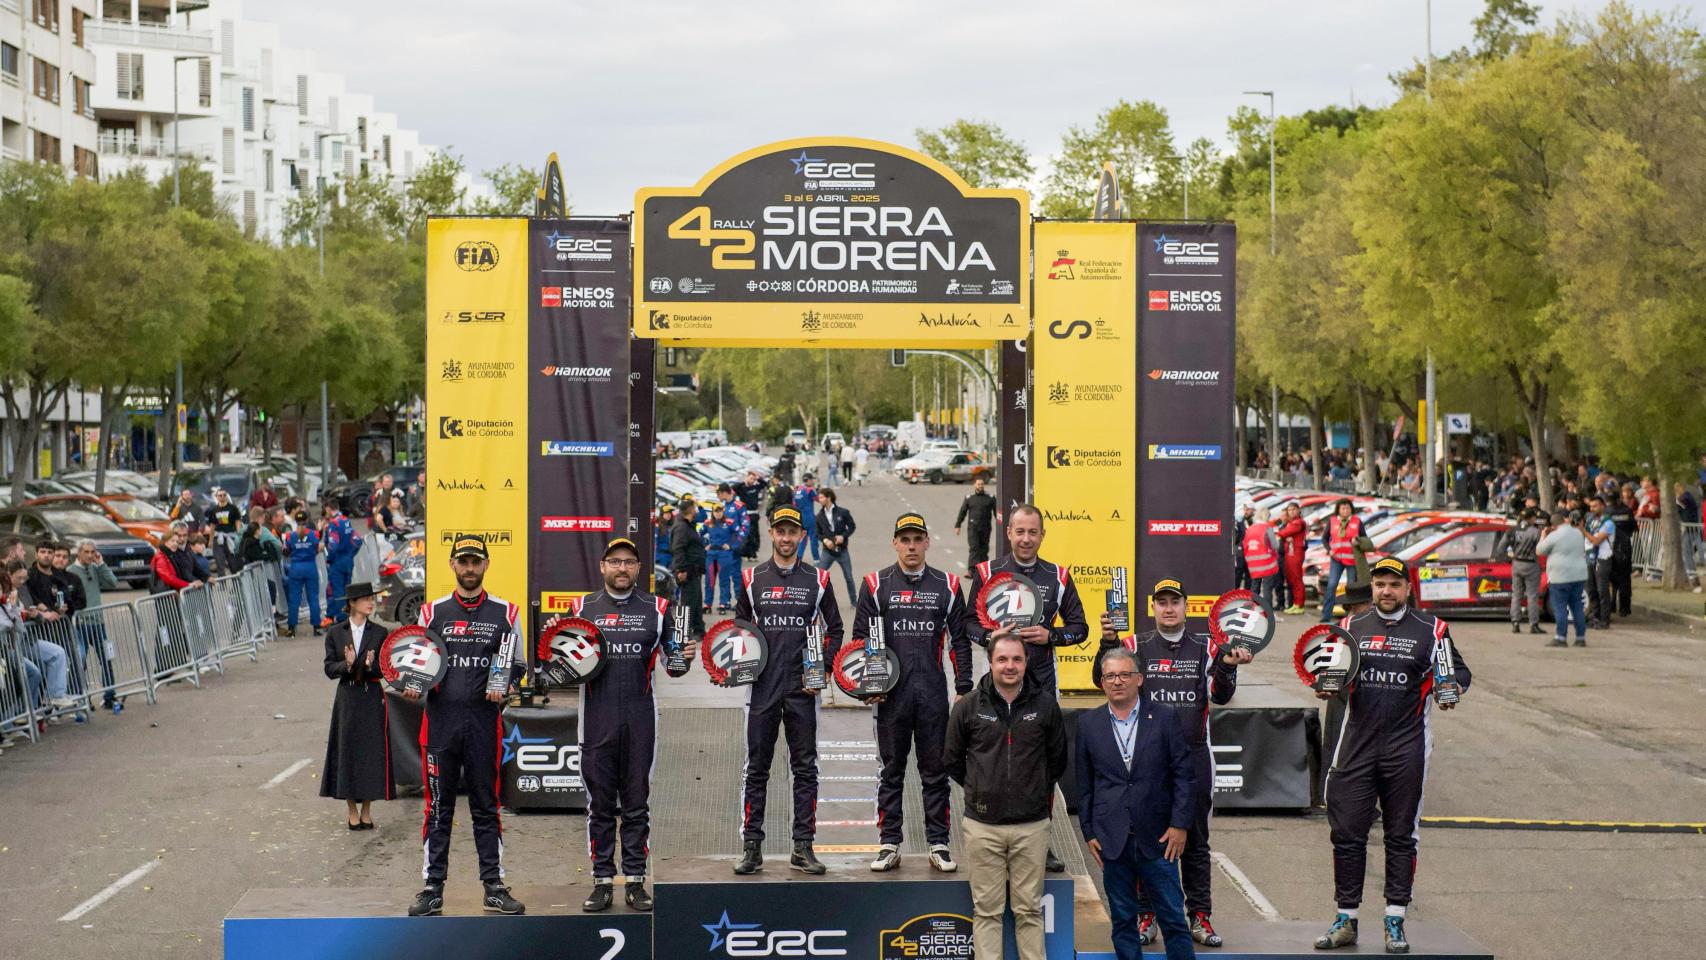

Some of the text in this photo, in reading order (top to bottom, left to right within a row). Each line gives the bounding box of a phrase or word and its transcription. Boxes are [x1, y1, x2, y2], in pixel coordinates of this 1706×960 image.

[804, 163, 876, 178] ERC
[713, 220, 755, 229] RALLY
[762, 206, 953, 236] SIERRA
[556, 239, 612, 252] ERC
[1163, 243, 1219, 255] ERC
[762, 241, 997, 271] MORENA
[796, 277, 870, 293] CÓRDOBA
[562, 287, 615, 299] ENEOS
[1169, 291, 1222, 303] ENEOS
[562, 300, 615, 308] MOTOR OIL
[673, 314, 712, 323] Diputación
[822, 313, 864, 321] AYUNTAMIENTO
[467, 362, 515, 370] AYUNTAMIENTO
[467, 371, 476, 379] DE
[1074, 385, 1122, 393] AYUNTAMIENTO
[1074, 393, 1082, 401] DE
[466, 419, 513, 430] Diputación
[466, 429, 514, 437] de Córdoba
[1074, 449, 1121, 459] Diputación
[1085, 458, 1122, 467] Córdoba
[543, 519, 612, 529] MRF TYRES
[1150, 523, 1219, 532] MRF TYRES
[1095, 577, 1112, 585] GRO
[761, 591, 783, 599] GR
[595, 618, 617, 626] GR
[442, 626, 467, 636] GR
[1359, 640, 1384, 650] GR
[1147, 663, 1171, 673] GR
[726, 930, 848, 956] ERC
